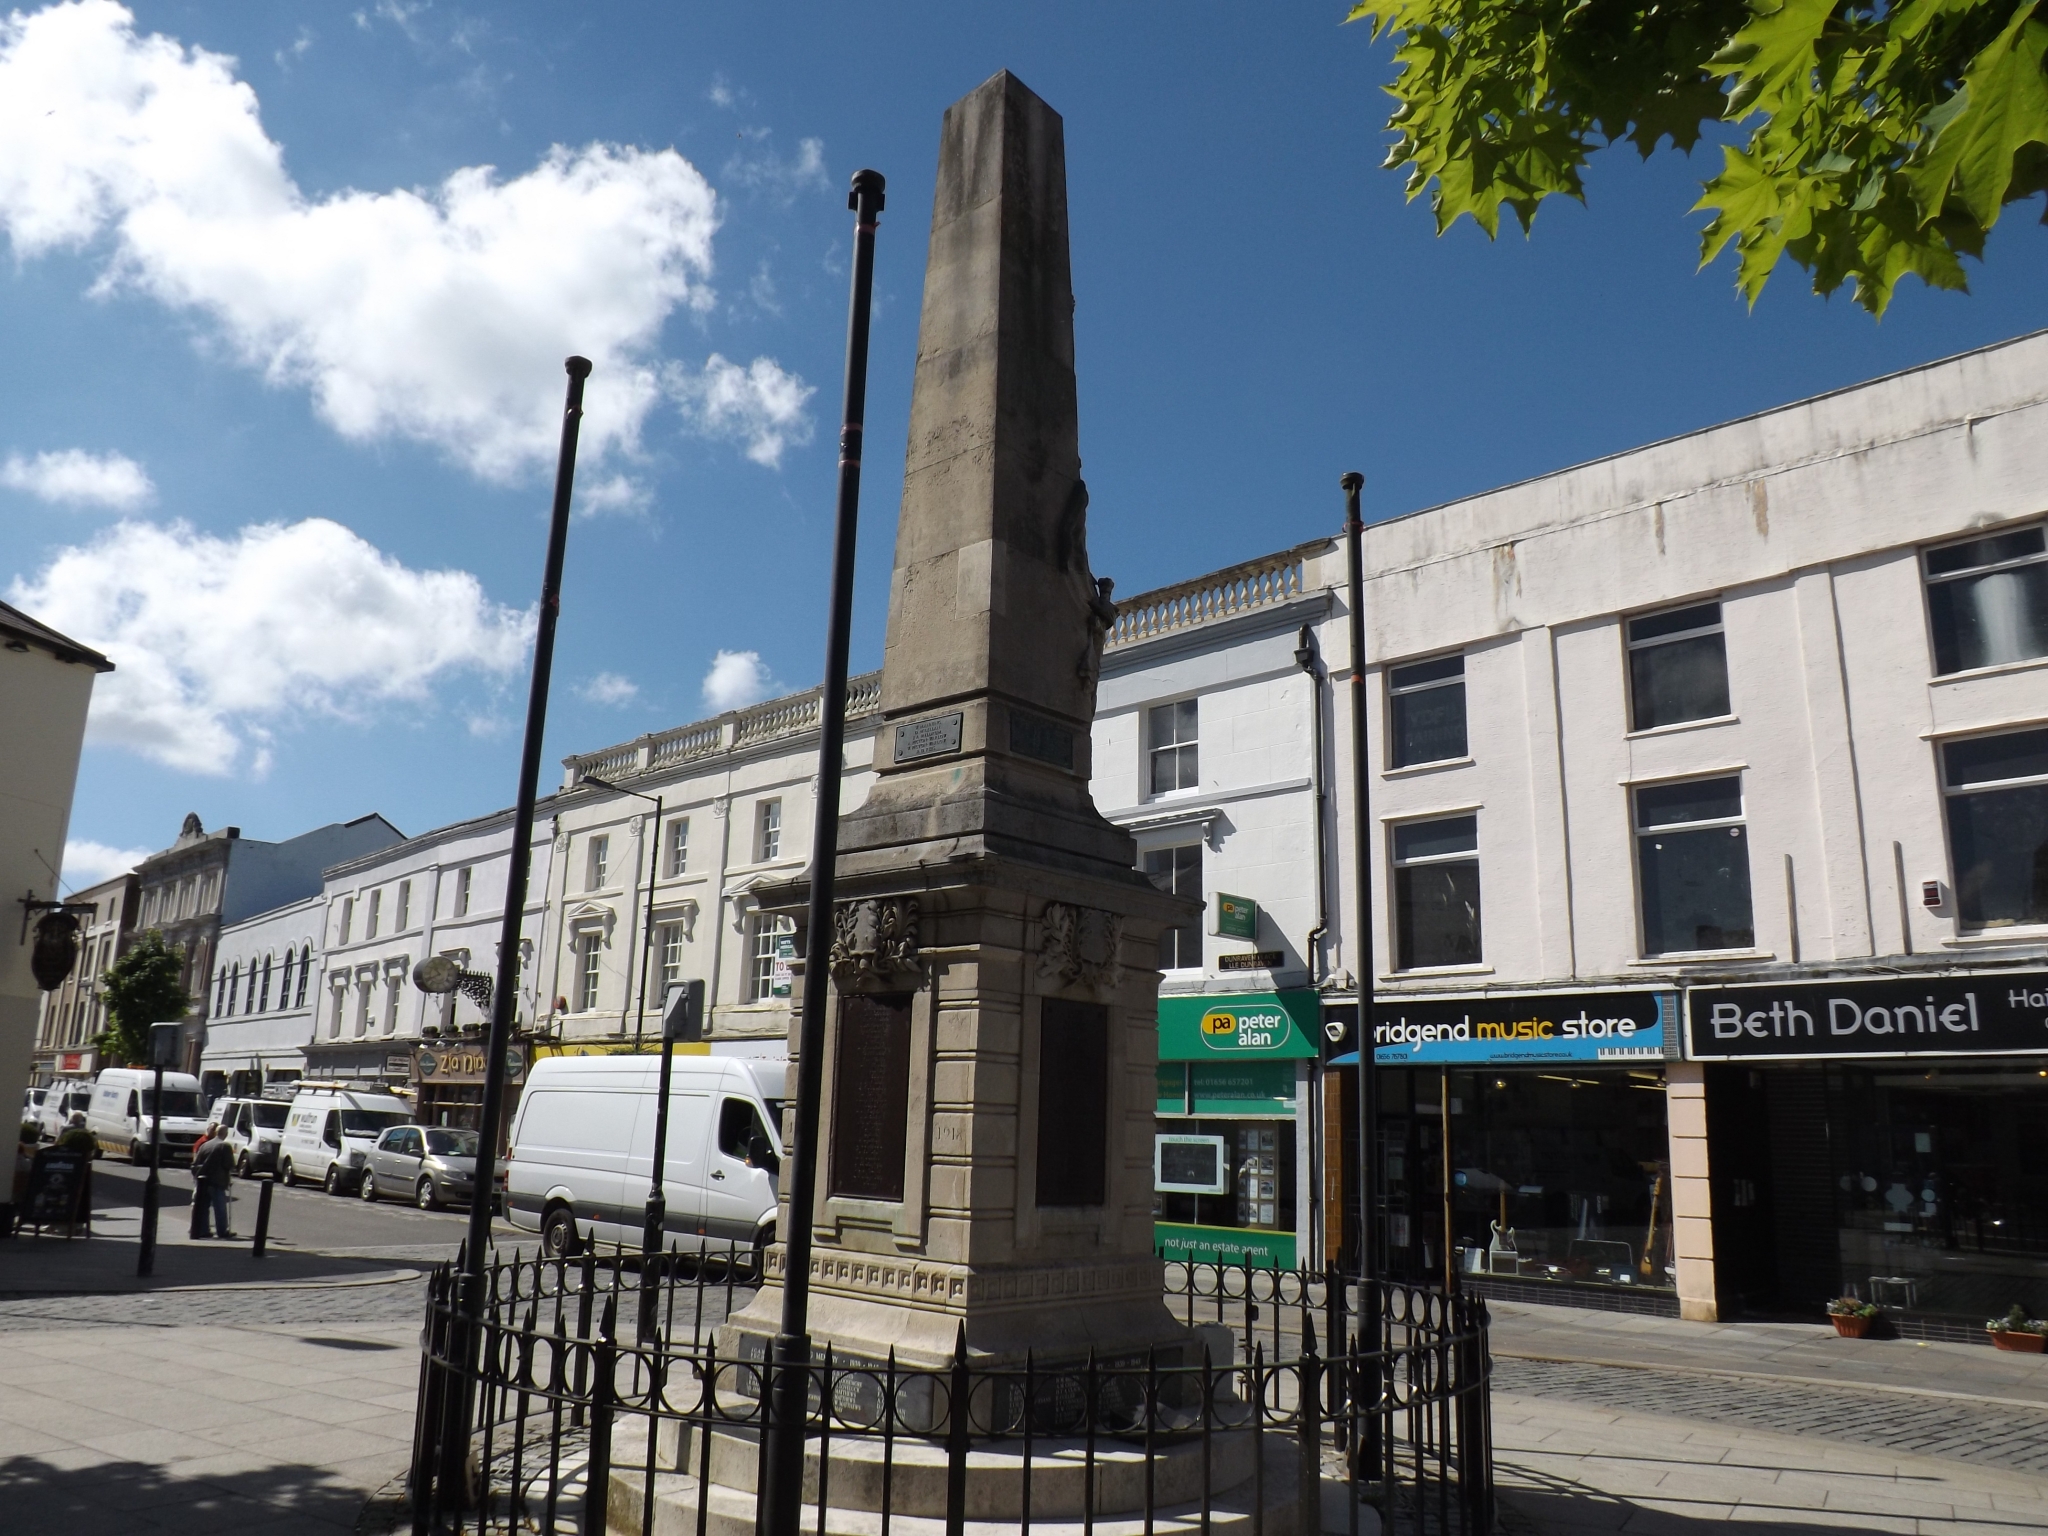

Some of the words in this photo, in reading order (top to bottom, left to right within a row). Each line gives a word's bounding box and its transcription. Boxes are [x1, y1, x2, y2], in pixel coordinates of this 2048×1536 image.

[1212, 1017, 1231, 1034] pa
[1238, 1014, 1281, 1033] peter
[1710, 1000, 1814, 1039] Beth
[1828, 992, 1980, 1036] Daniel
[1238, 1028, 1271, 1046] alan
[1373, 1014, 1470, 1053] ridgend
[1477, 1016, 1554, 1041] music
[1562, 1010, 1637, 1039] store
[1205, 1078, 1226, 1086] 01656
[1227, 1078, 1254, 1086] 657201
[1164, 1238, 1180, 1248] not
[1180, 1238, 1198, 1252] just
[1199, 1242, 1210, 1250] an
[1212, 1242, 1240, 1252] estate
[1241, 1245, 1269, 1256] agent
